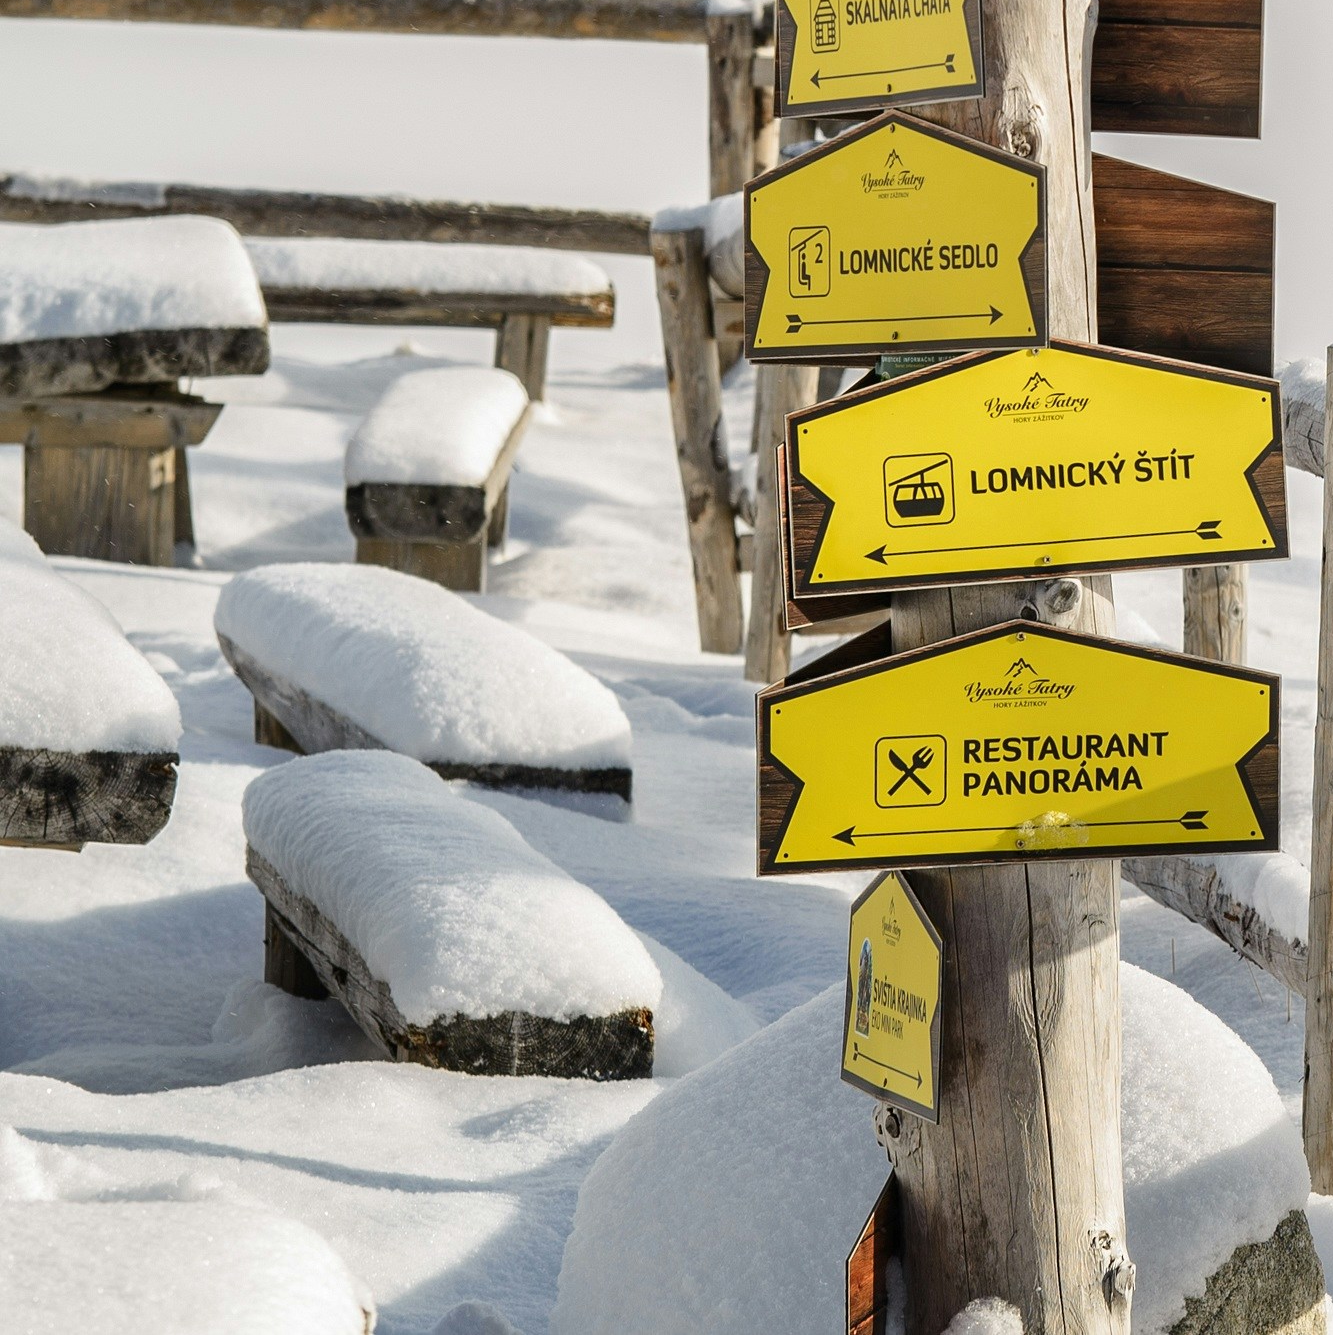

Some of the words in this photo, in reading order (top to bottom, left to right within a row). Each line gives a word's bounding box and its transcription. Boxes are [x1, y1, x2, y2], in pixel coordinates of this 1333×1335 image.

[897, 170, 925, 191] Tatry
[814, 243, 823, 264] 2
[840, 239, 934, 275] LOMNICKÉ
[938, 243, 998, 271] SEDLO
[984, 395, 1040, 419] Vysoké
[1044, 392, 1090, 413] Tatry
[970, 452, 1126, 494] LOMNICKÝ
[1134, 448, 1195, 482] ŠTÍT
[964, 680, 1023, 703] Vysoké
[1027, 679, 1076, 699] Tatry
[963, 732, 1169, 764] RESTAURANT
[963, 760, 1143, 797] PANORÁMA
